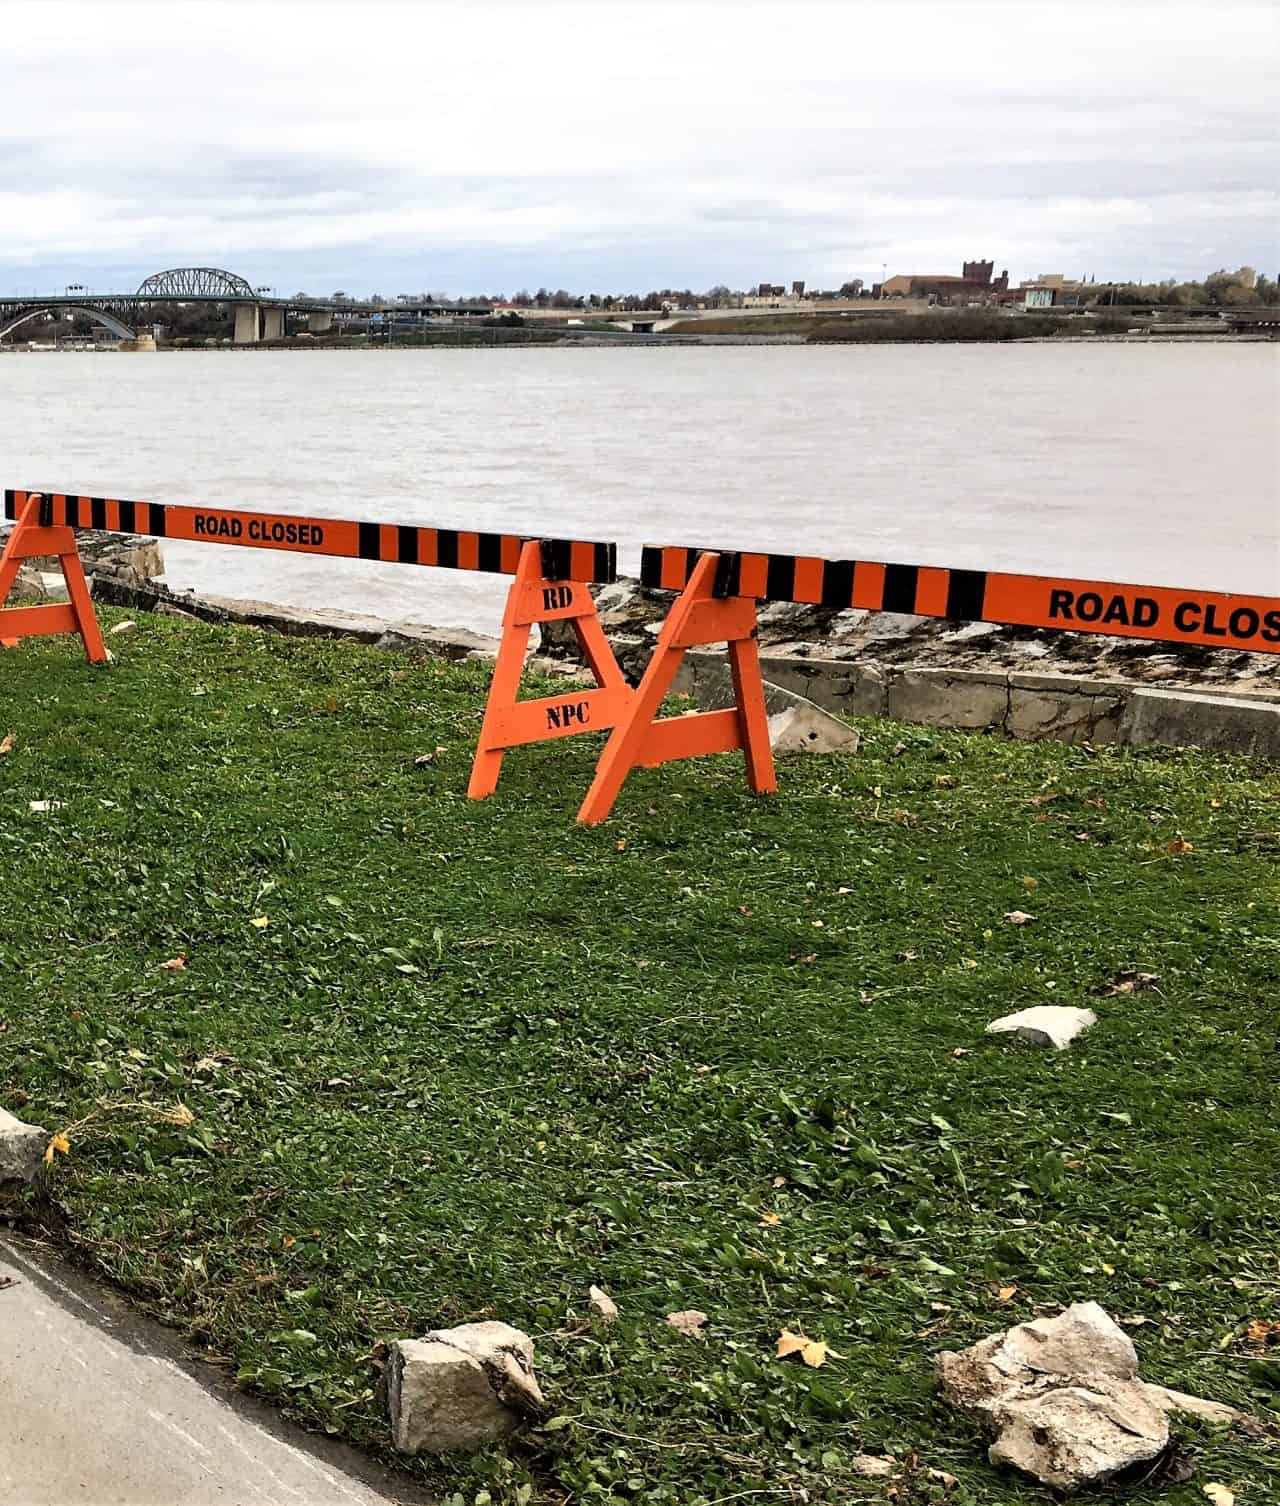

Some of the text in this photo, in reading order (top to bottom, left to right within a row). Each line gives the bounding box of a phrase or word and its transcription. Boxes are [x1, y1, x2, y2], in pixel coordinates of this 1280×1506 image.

[194, 515, 323, 545] ROAD CLOSED
[542, 586, 573, 611] RD
[1049, 589, 1159, 627] ROAD
[546, 701, 590, 729] NPC
